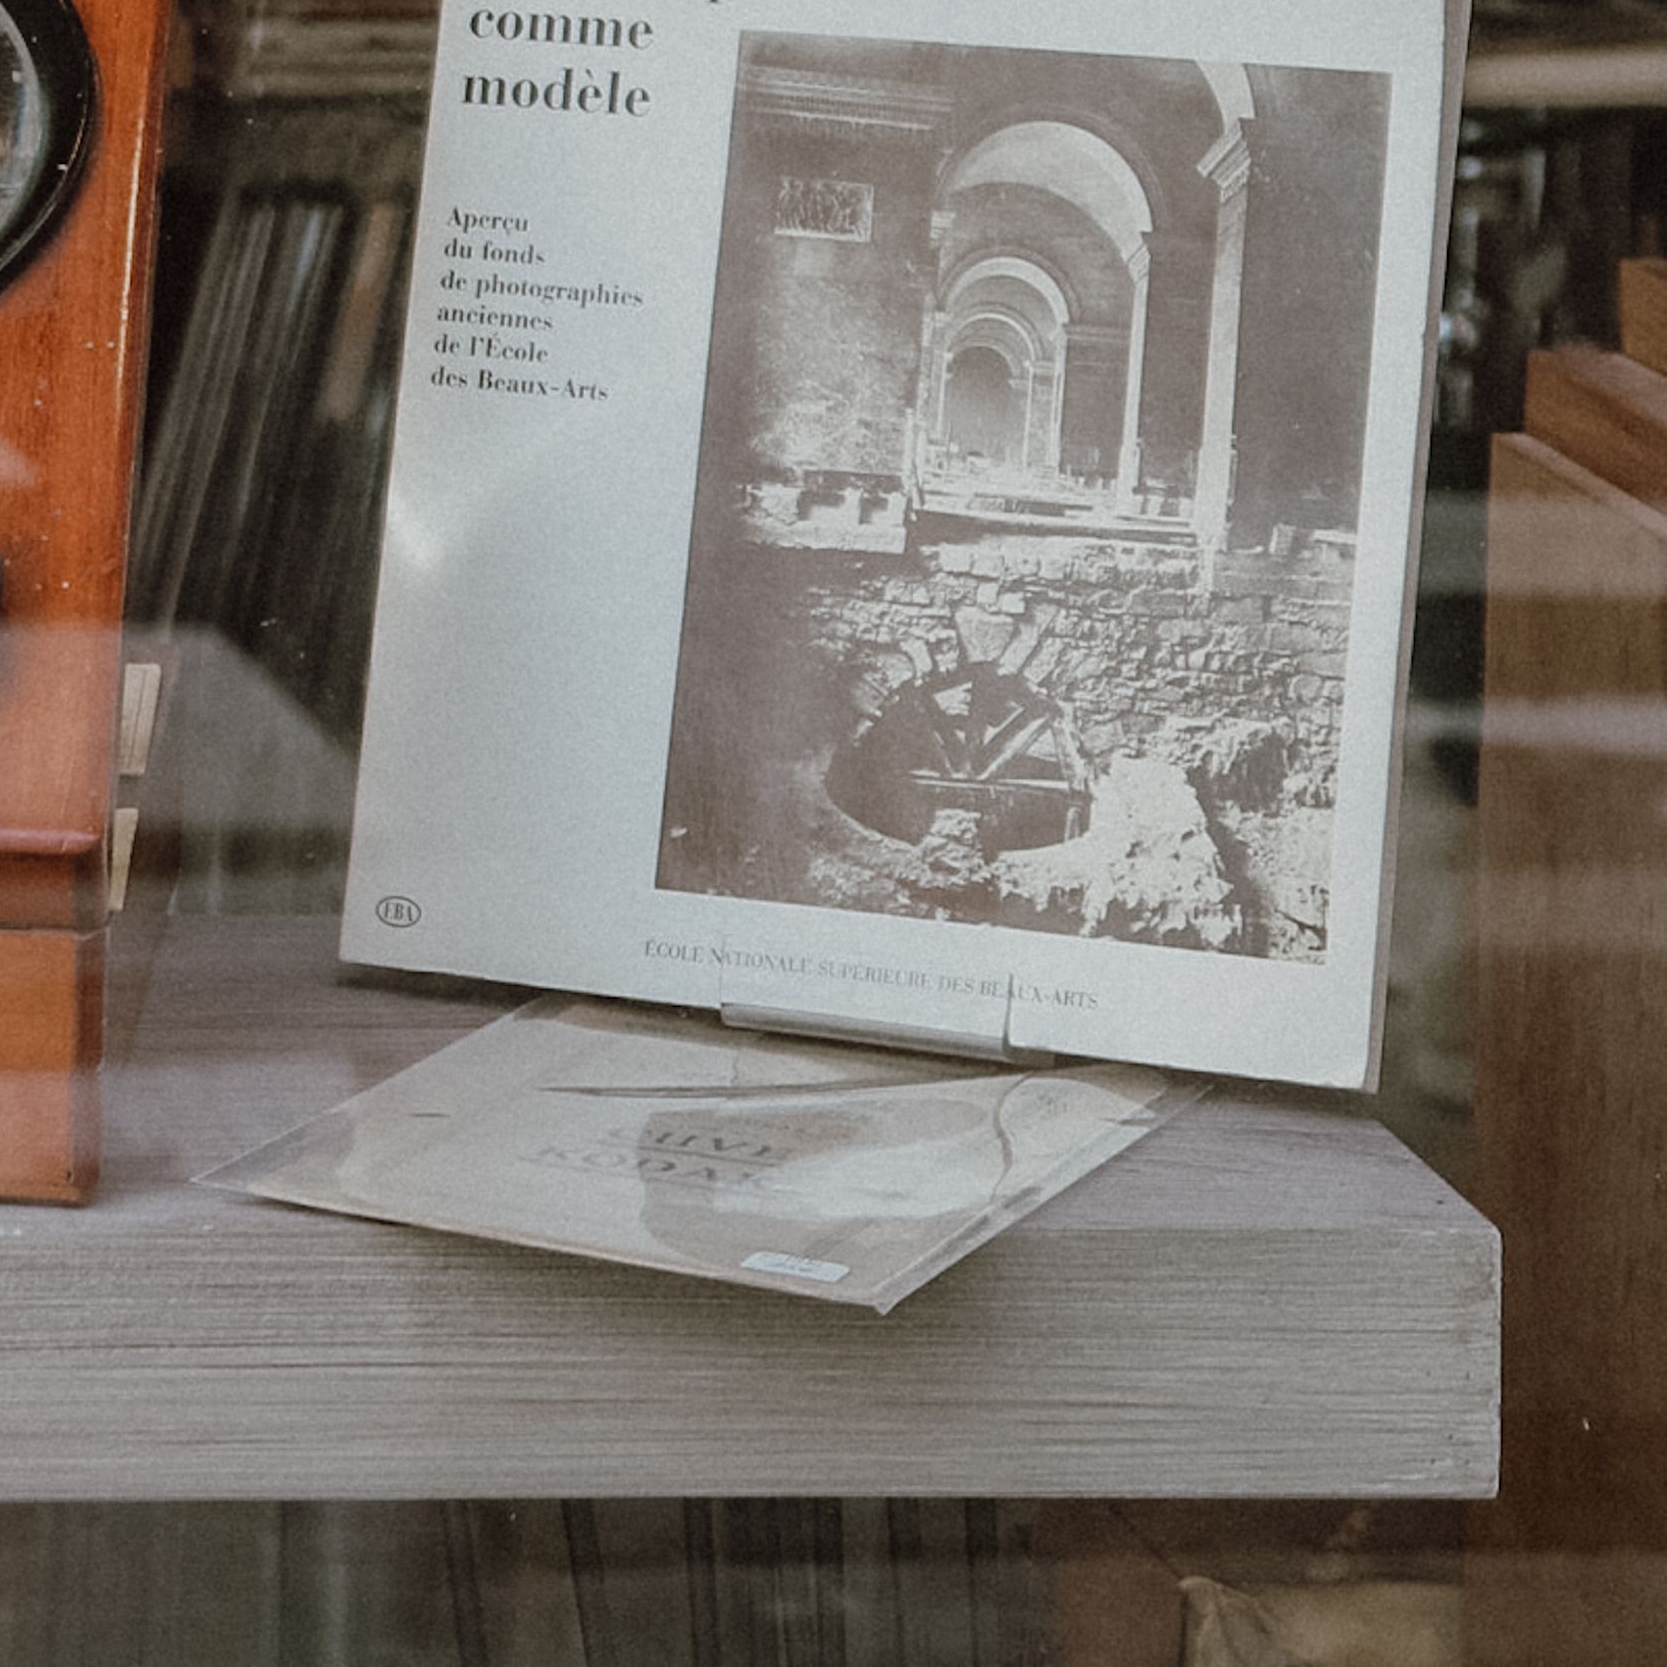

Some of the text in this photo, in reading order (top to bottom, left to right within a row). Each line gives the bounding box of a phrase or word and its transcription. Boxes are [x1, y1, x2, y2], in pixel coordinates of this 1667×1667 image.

[468, 8, 654, 50] comme
[461, 68, 652, 117] modèle
[447, 206, 529, 237] Aperçu
[443, 238, 546, 265] du fonds
[439, 269, 643, 309] de photographies
[436, 304, 553, 331] anciennes
[434, 331, 549, 363] de l'École
[430, 366, 609, 401] des Beaux-Arts
[937, 975, 975, 993] DES
